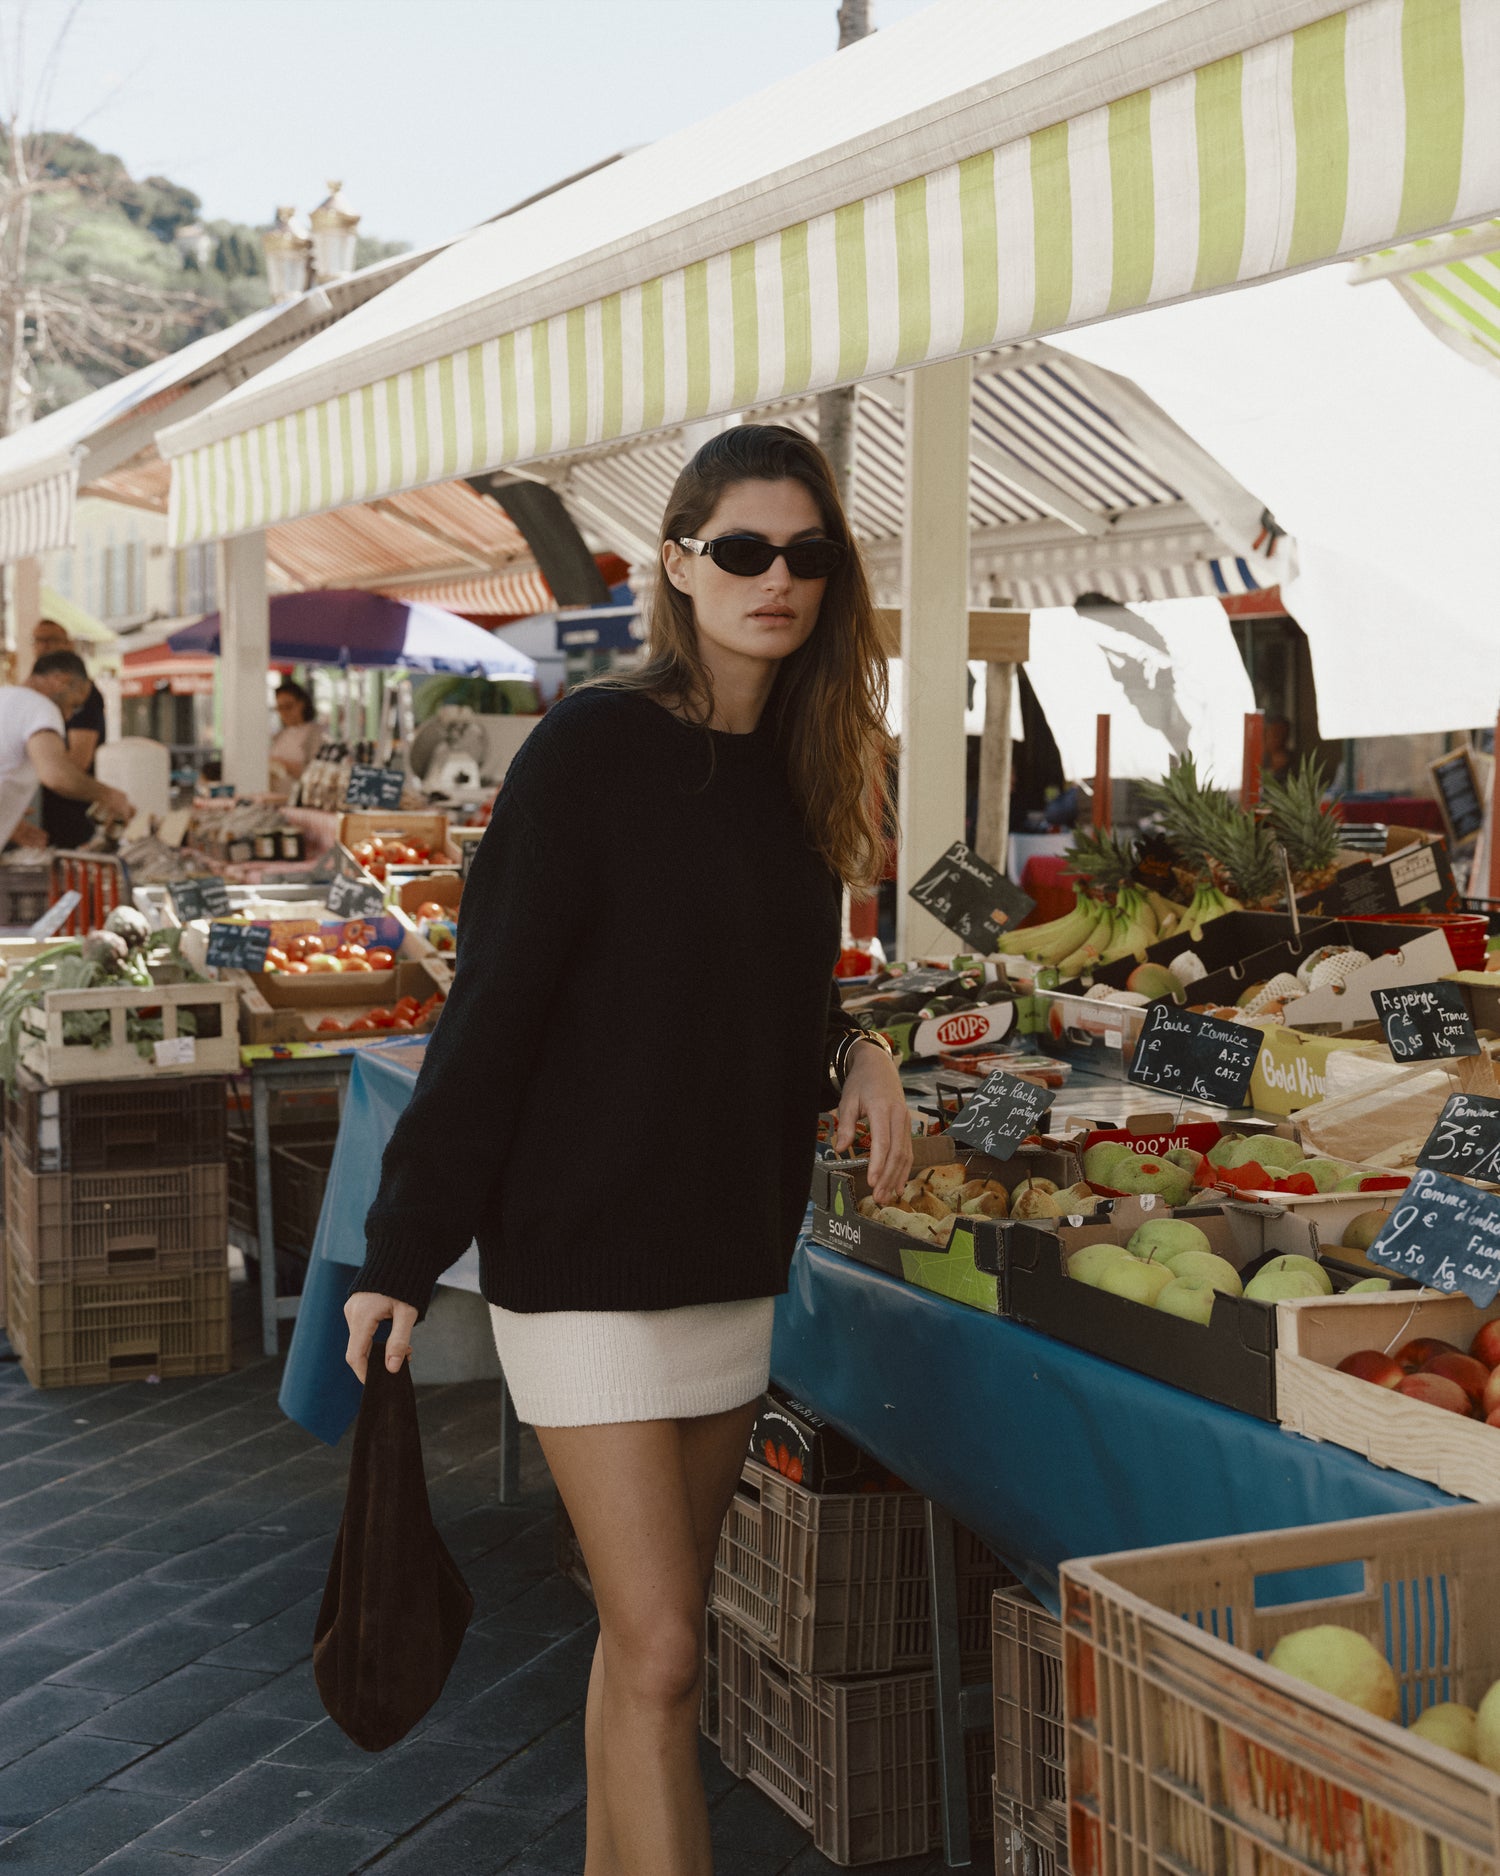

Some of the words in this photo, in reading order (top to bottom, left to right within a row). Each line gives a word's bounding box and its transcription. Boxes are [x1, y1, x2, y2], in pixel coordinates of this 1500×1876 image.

[946, 844, 993, 887] Banane
[1380, 991, 1438, 1014] Asperge
[1437, 1007, 1469, 1021] France
[938, 1016, 987, 1043] TROPS
[1151, 1004, 1192, 1033] Poire
[1433, 1032, 1455, 1054] Kg
[983, 1070, 1008, 1096] Poire
[1261, 1048, 1297, 1094] Gold
[1191, 1076, 1216, 1099] Kg
[981, 1130, 997, 1153] Kg
[828, 1219, 861, 1245] savibel
[1433, 1256, 1456, 1290] Kg
